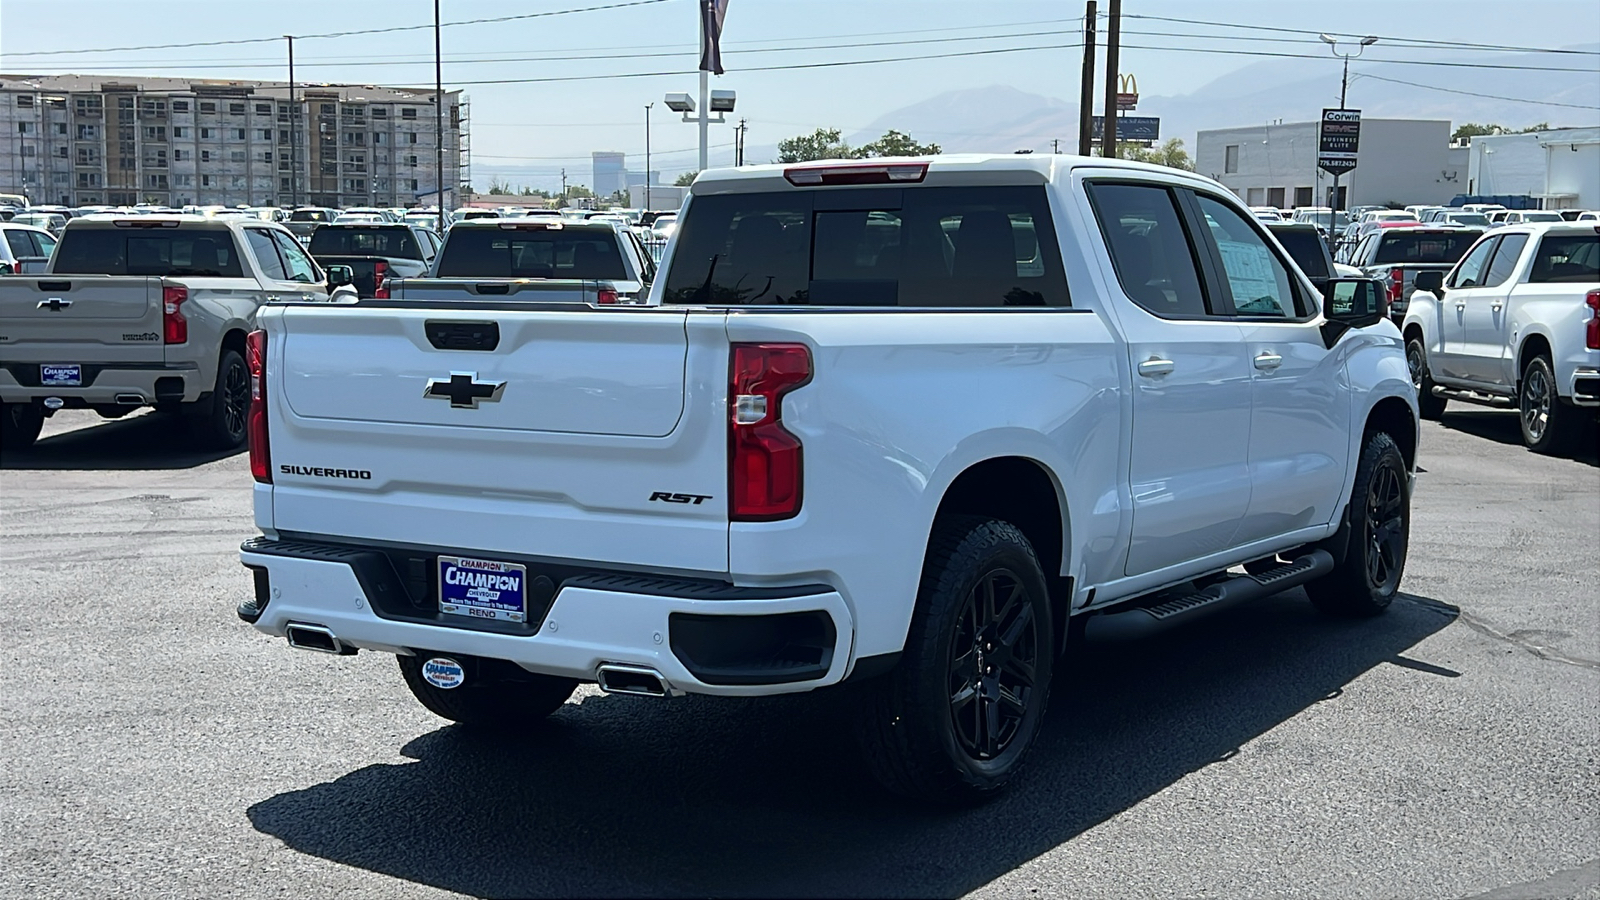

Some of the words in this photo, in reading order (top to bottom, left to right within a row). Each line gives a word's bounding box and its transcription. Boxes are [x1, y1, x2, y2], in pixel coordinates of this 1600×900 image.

[1326, 112, 1360, 121] Corwin
[43, 367, 79, 375] CHAMPION
[280, 464, 372, 480] SILVERADO
[648, 491, 714, 505] RST
[461, 560, 501, 570] CHAMPION
[445, 567, 519, 591] CHAMPION
[469, 590, 498, 598] CHEVROLET
[469, 609, 496, 617] RENO
